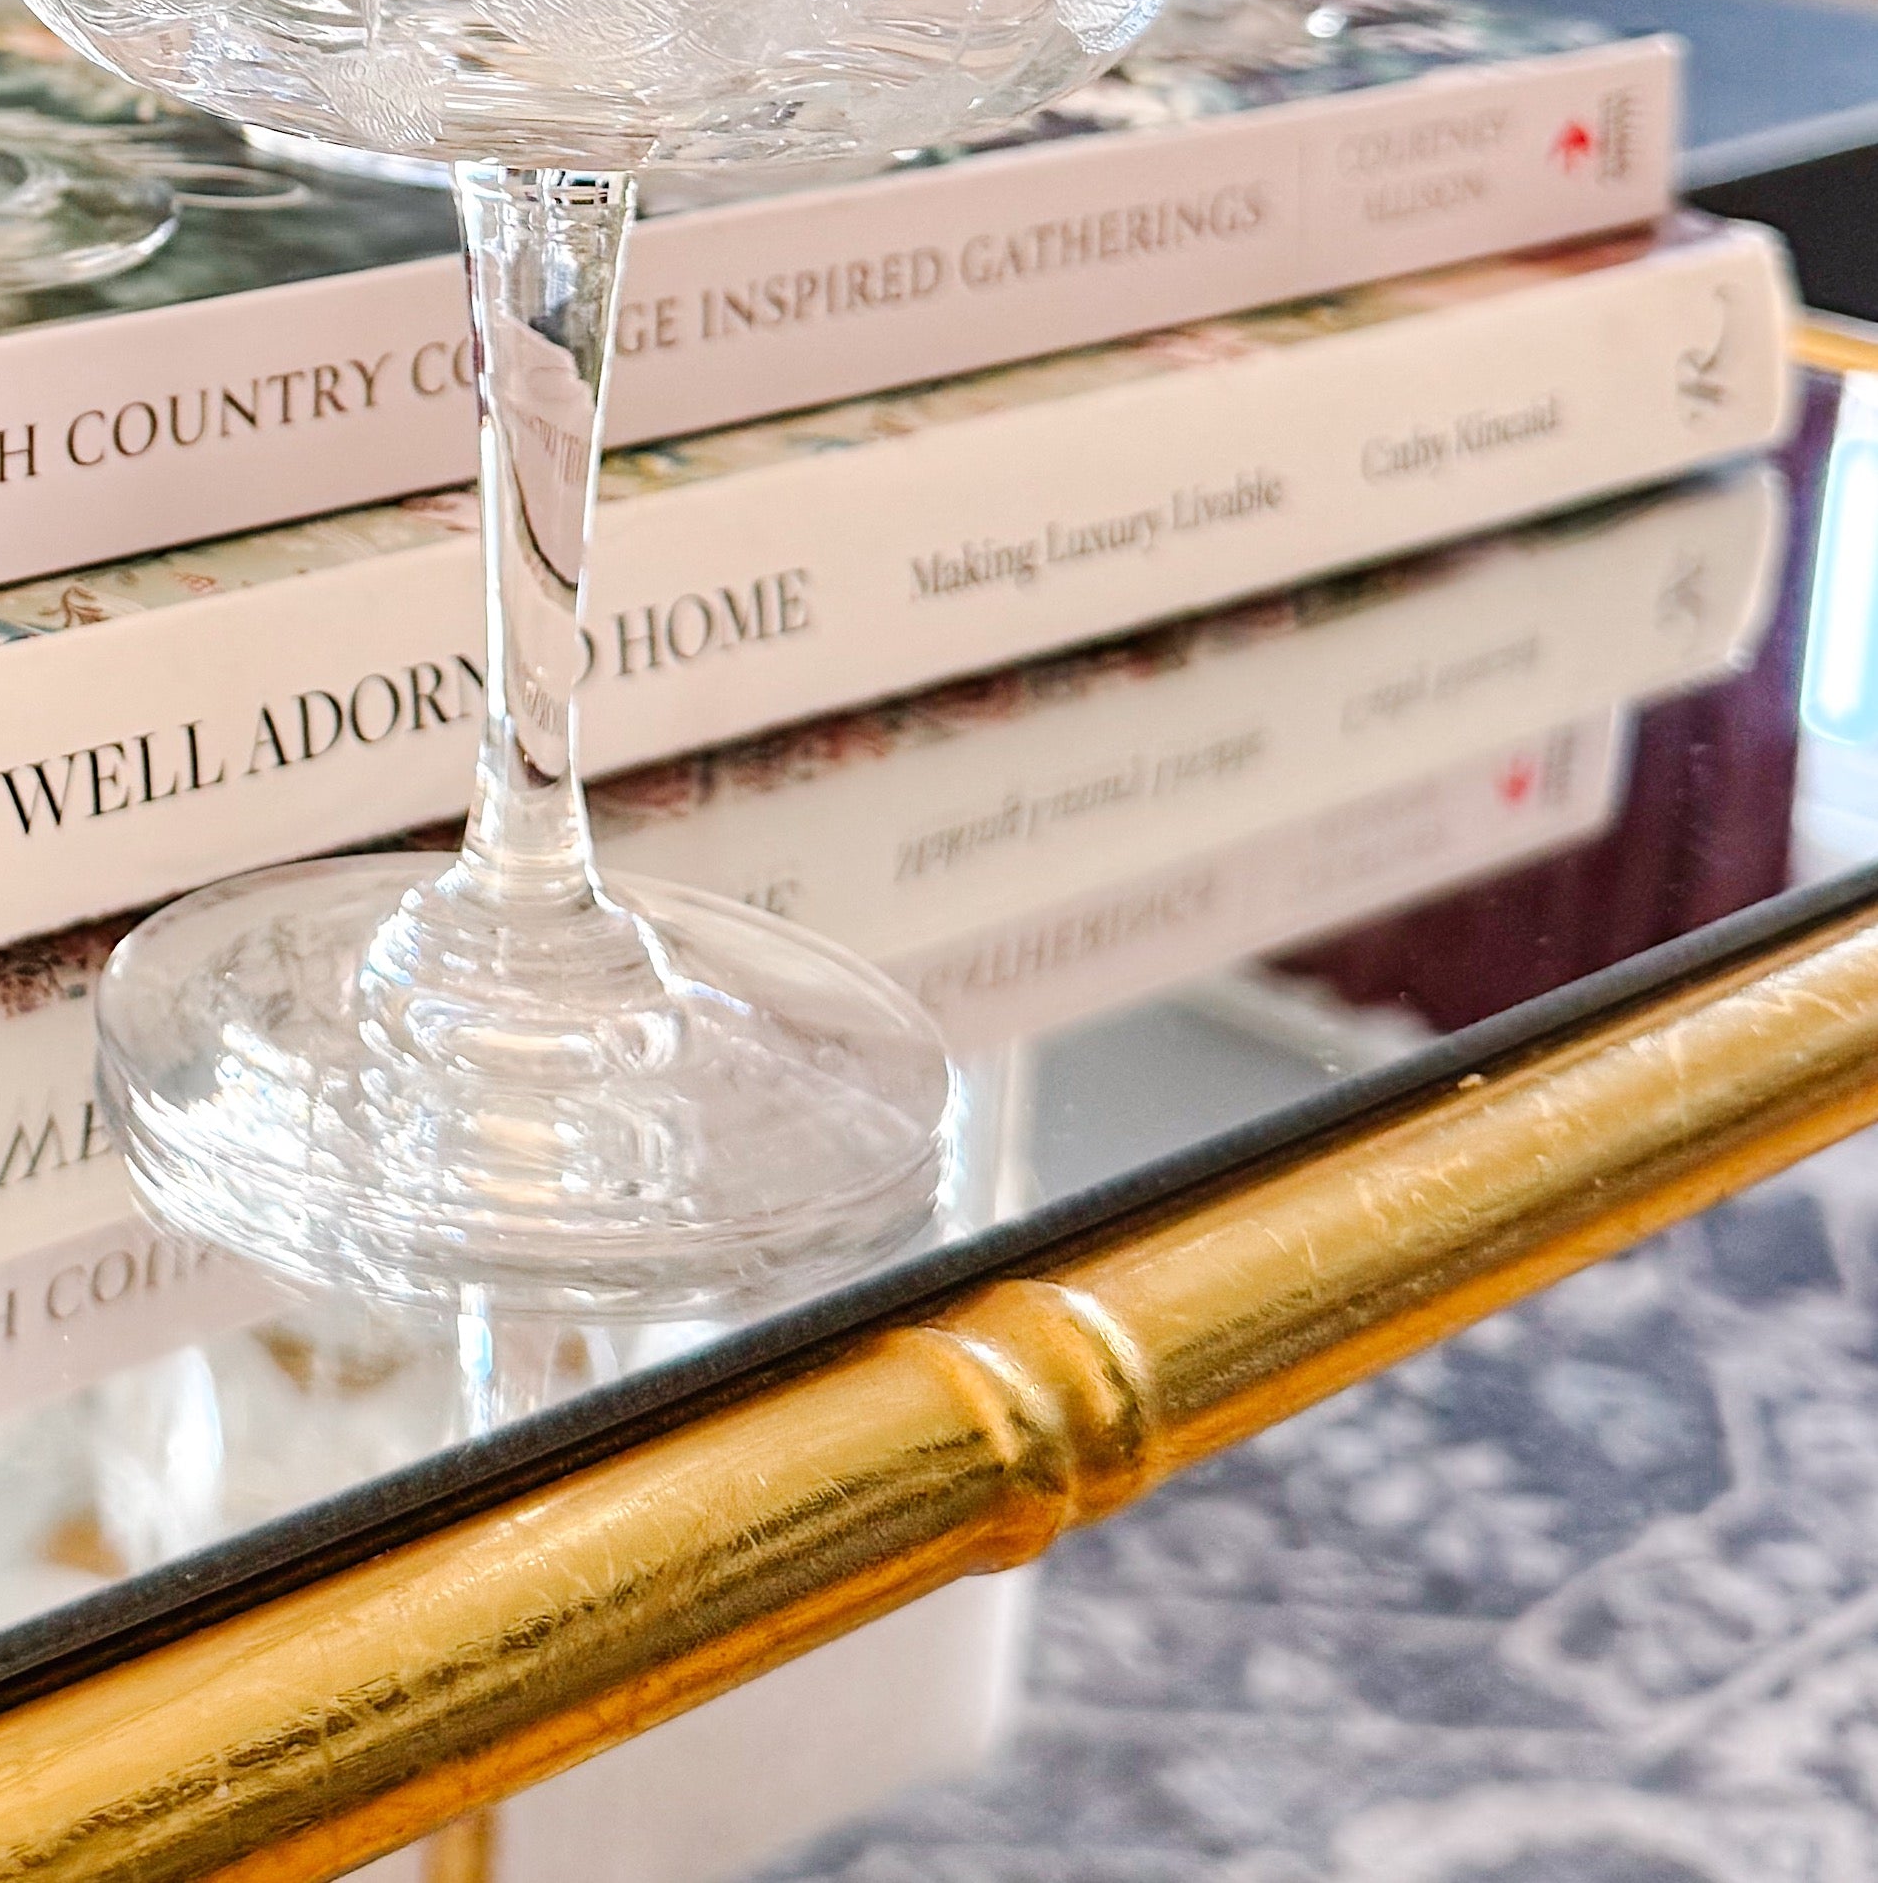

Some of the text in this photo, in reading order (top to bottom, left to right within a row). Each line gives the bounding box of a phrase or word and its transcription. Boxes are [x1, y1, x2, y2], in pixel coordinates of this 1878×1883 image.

[65, 350, 393, 469] COUNTRY
[701, 245, 944, 341] INSPIRED
[960, 180, 1271, 286] GATHERINGS
[909, 465, 1286, 602] Making Luxury Livable
[246, 625, 595, 776] ADORND
[616, 565, 813, 678] HOME
